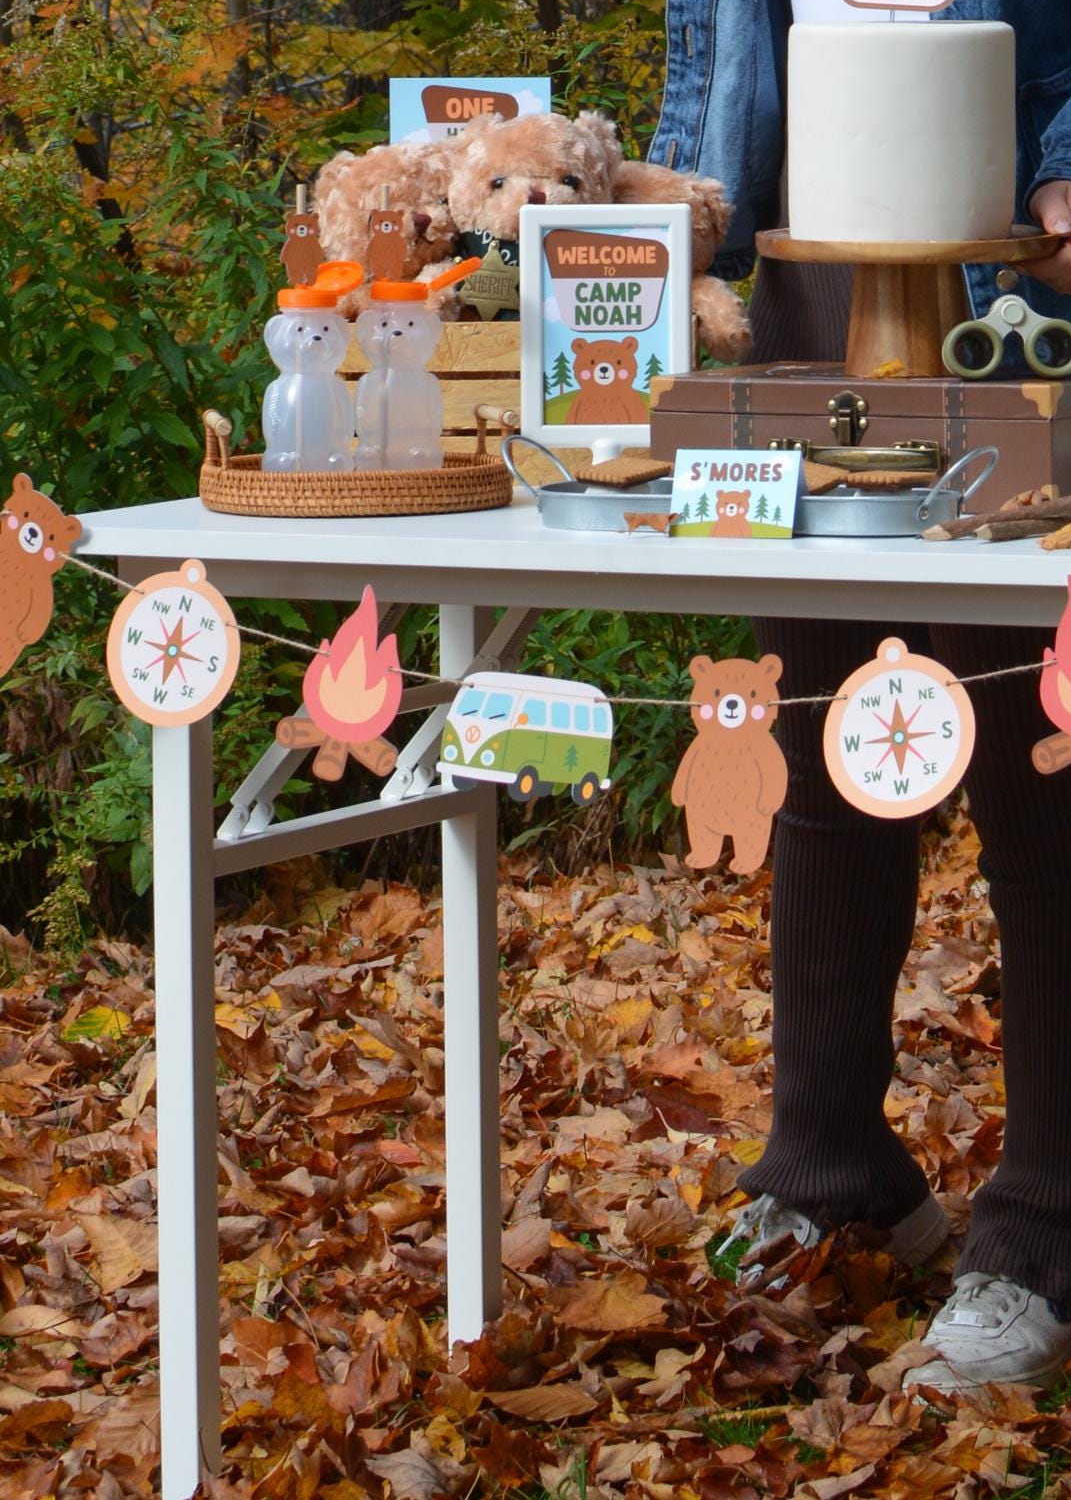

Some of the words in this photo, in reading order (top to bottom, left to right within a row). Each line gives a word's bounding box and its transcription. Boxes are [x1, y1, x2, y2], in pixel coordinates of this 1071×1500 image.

[557, 245, 657, 265] WELCOME
[603, 266, 616, 277] TO
[464, 274, 515, 296] SHERIFF
[574, 282, 642, 303] CAMP
[574, 305, 642, 326] NOAH
[691, 461, 783, 482] S'MORES
[152, 600, 171, 615] NW
[178, 595, 192, 612] N
[200, 617, 216, 631] NE
[127, 627, 143, 645] W
[207, 655, 220, 673] S
[131, 667, 150, 682] SW
[180, 685, 196, 699] SE
[889, 677, 903, 695] N
[918, 687, 935, 701] NE
[153, 687, 168, 705] W
[861, 695, 881, 709] NW
[941, 720, 953, 739] S
[844, 734, 860, 753] W
[864, 770, 883, 784] SW
[923, 762, 938, 775] SE
[894, 778, 910, 796] W
